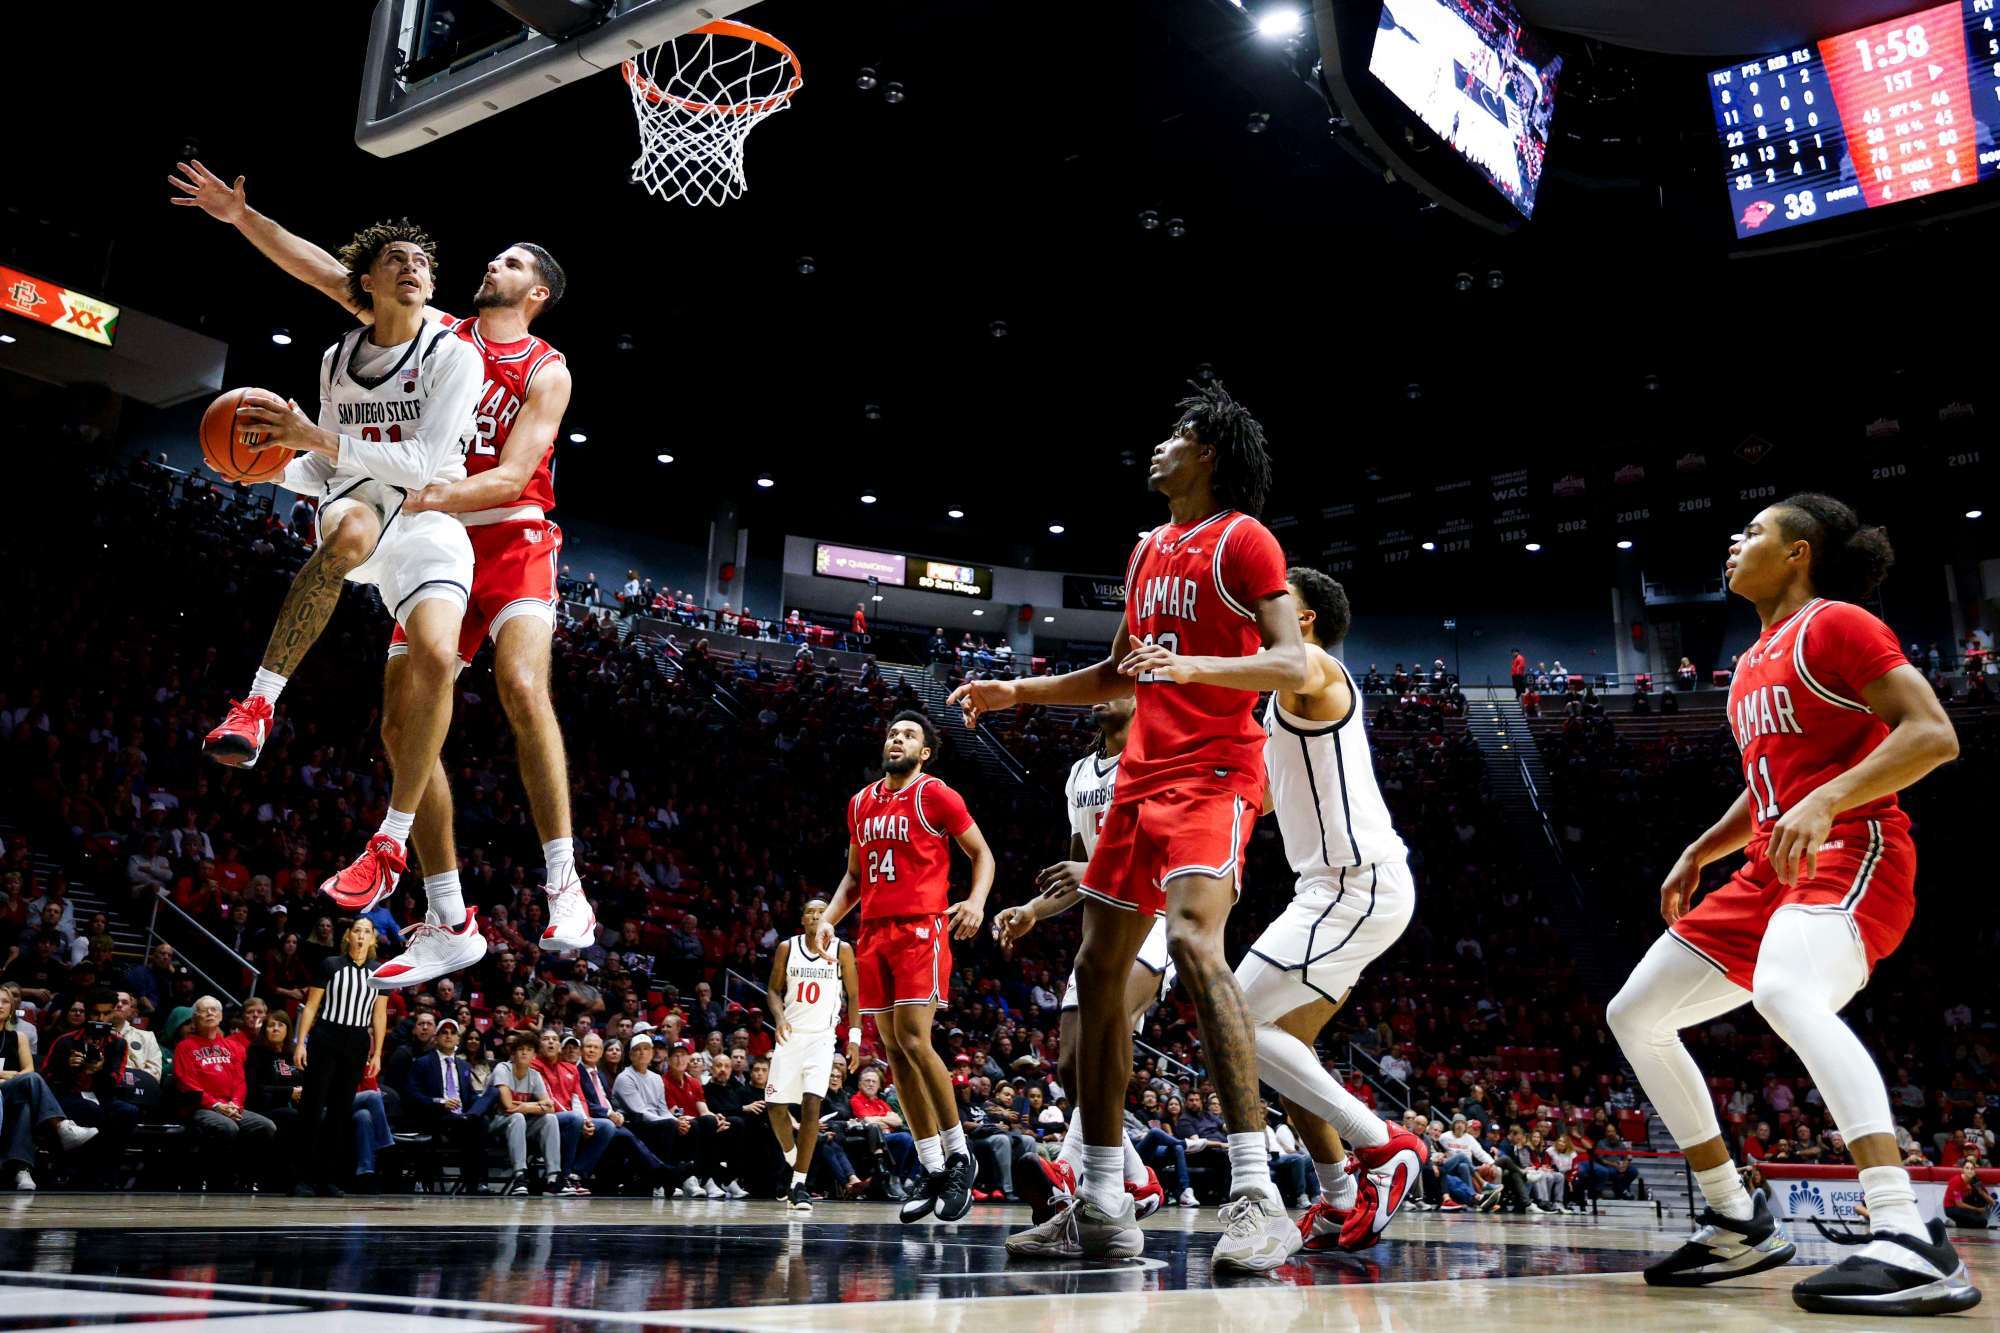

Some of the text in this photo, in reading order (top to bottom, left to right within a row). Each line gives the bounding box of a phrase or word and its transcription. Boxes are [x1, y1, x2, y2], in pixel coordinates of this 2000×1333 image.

[1983, 16, 1993, 31] 4
[1856, 25, 1929, 72] 1:58
[1989, 39, 1999, 54] 5
[1713, 70, 1731, 86] PLY
[1741, 62, 1761, 78] PTS
[1792, 48, 1810, 64] FLS
[1721, 68, 1810, 104] 8 9 1 2
[1883, 69, 1912, 94] 1ST
[1723, 90, 1814, 126] 11 0 0 0
[1862, 106, 1881, 125] 45
[1727, 112, 1818, 147] 22 8 3 0
[1731, 133, 1822, 169] 24 13 3 1
[1735, 155, 1826, 190] 32 2 4 1
[1874, 165, 1892, 183] 10
[1882, 185, 1893, 200] 4
[1951, 168, 1962, 184] 4
[1783, 190, 1817, 220] 38
[67, 306, 103, 333] XX
[338, 403, 353, 424] SAN
[355, 402, 385, 424] DIEGO
[1872, 463, 1907, 480] 2010
[1948, 451, 1980, 467] 2011
[1492, 486, 1528, 501] WAC
[935, 579, 952, 590] San
[954, 582, 981, 595] Diego
[1092, 581, 1125, 597] VIEJAS
[1735, 685, 1803, 750] AMAR
[1747, 756, 1780, 823] 11
[857, 815, 909, 847] LAMAR
[868, 848, 896, 883] 24
[790, 967, 834, 979] SAN DIEGO STATE
[796, 981, 820, 1004] 10
